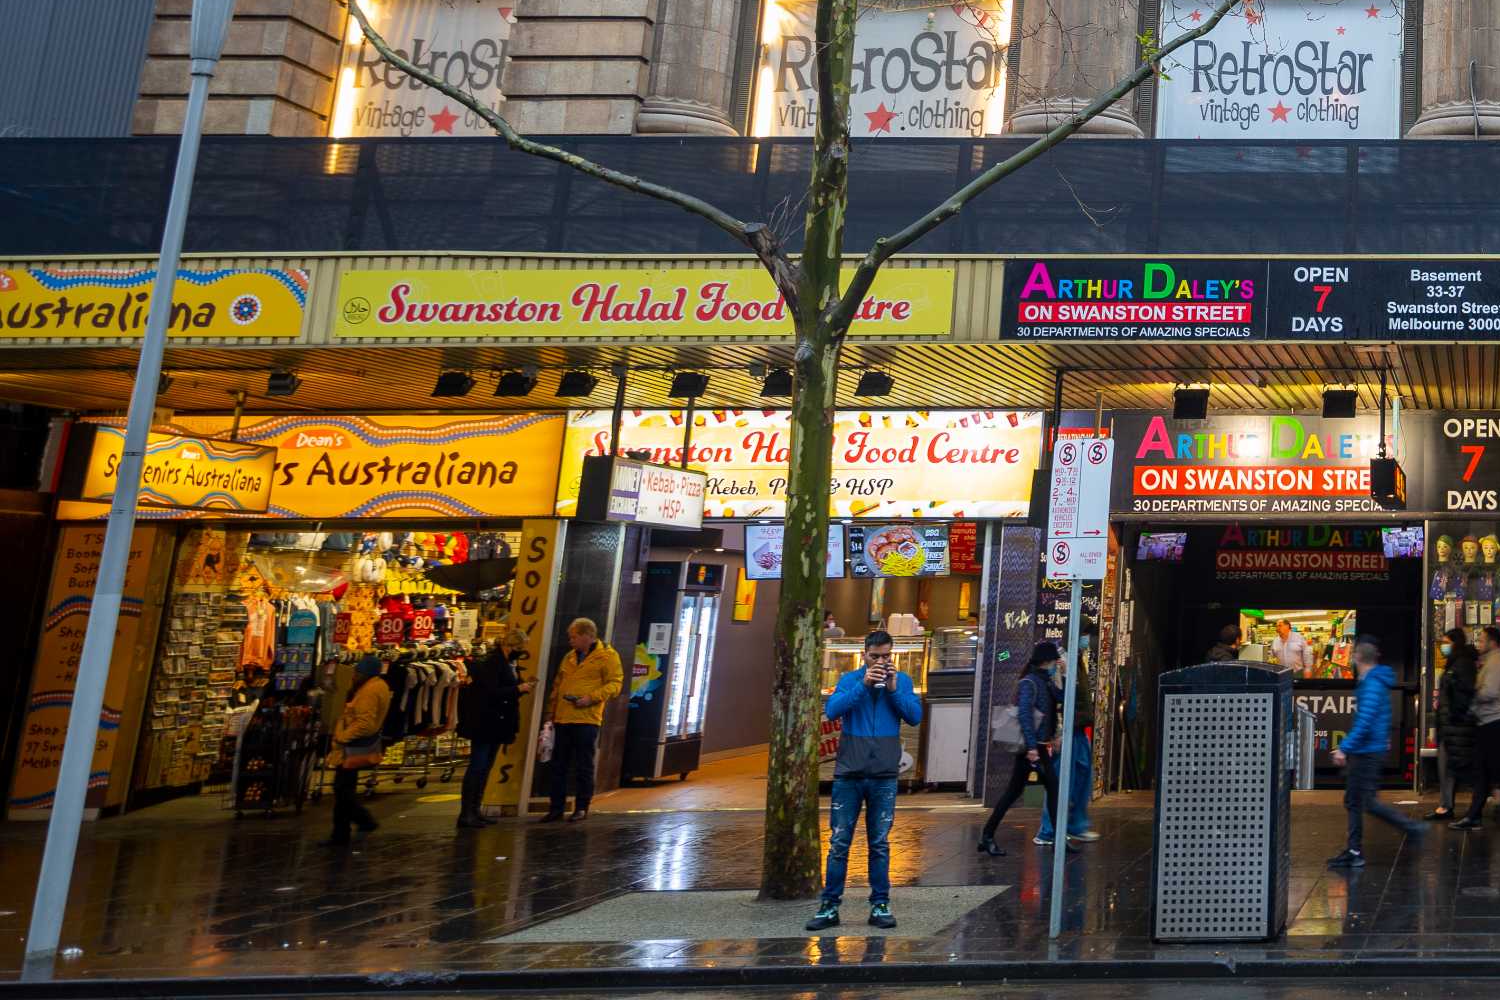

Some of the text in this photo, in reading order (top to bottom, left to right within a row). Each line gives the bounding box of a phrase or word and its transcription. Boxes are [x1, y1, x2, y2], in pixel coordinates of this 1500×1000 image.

[352, 38, 510, 91] RetroSt
[1191, 39, 1374, 96] RetroStar
[355, 100, 426, 137] vintage
[779, 98, 853, 136] vint
[908, 97, 985, 137] clothing
[1200, 96, 1360, 131] vintage clothing
[1020, 262, 1255, 299] ARTHUR DALEY'S
[1293, 266, 1350, 283] OPEN
[1410, 269, 1482, 282] Basement
[378, 283, 562, 323] Swanston
[572, 282, 688, 322] Halal
[696, 282, 786, 321] Food
[1312, 285, 1334, 313] 7
[1426, 285, 1465, 298] 33-37
[0, 292, 217, 333] ustralina
[1024, 305, 1247, 321] ON SWANSTON STREET
[1386, 301, 1458, 314] Swanston
[1017, 327, 1251, 337] 30 DEPARTMENTS OF AMAZING SPECIALS
[1291, 316, 1343, 333] DAYS
[1388, 317, 1465, 331] Melbourne
[295, 431, 345, 449] Dean's
[845, 431, 919, 464] Food
[927, 431, 1020, 464] Centre
[104, 453, 181, 485] Senirs
[184, 463, 262, 492] Australiana
[306, 451, 519, 489] Australiana
[1460, 445, 1486, 482] 7
[646, 471, 676, 494] Kebab
[846, 478, 894, 496] HSP
[1140, 469, 1371, 491] ON SWANSTON STRE
[662, 499, 681, 519] HSP
[1133, 500, 1151, 511] 30
[1152, 500, 1248, 512] DEPARTMENTS
[1250, 500, 1267, 511] OF
[1271, 500, 1331, 512] AMAZING
[1447, 490, 1498, 511] DAYS
[1307, 523, 1380, 548] DALEY'
[1217, 553, 1386, 569] ON SWANSTON STREET
[1228, 572, 1293, 580] DEPARTMENTS
[1296, 572, 1308, 580] OF
[1309, 572, 1349, 580] AMAZING
[1350, 572, 1390, 581] SPECIALS
